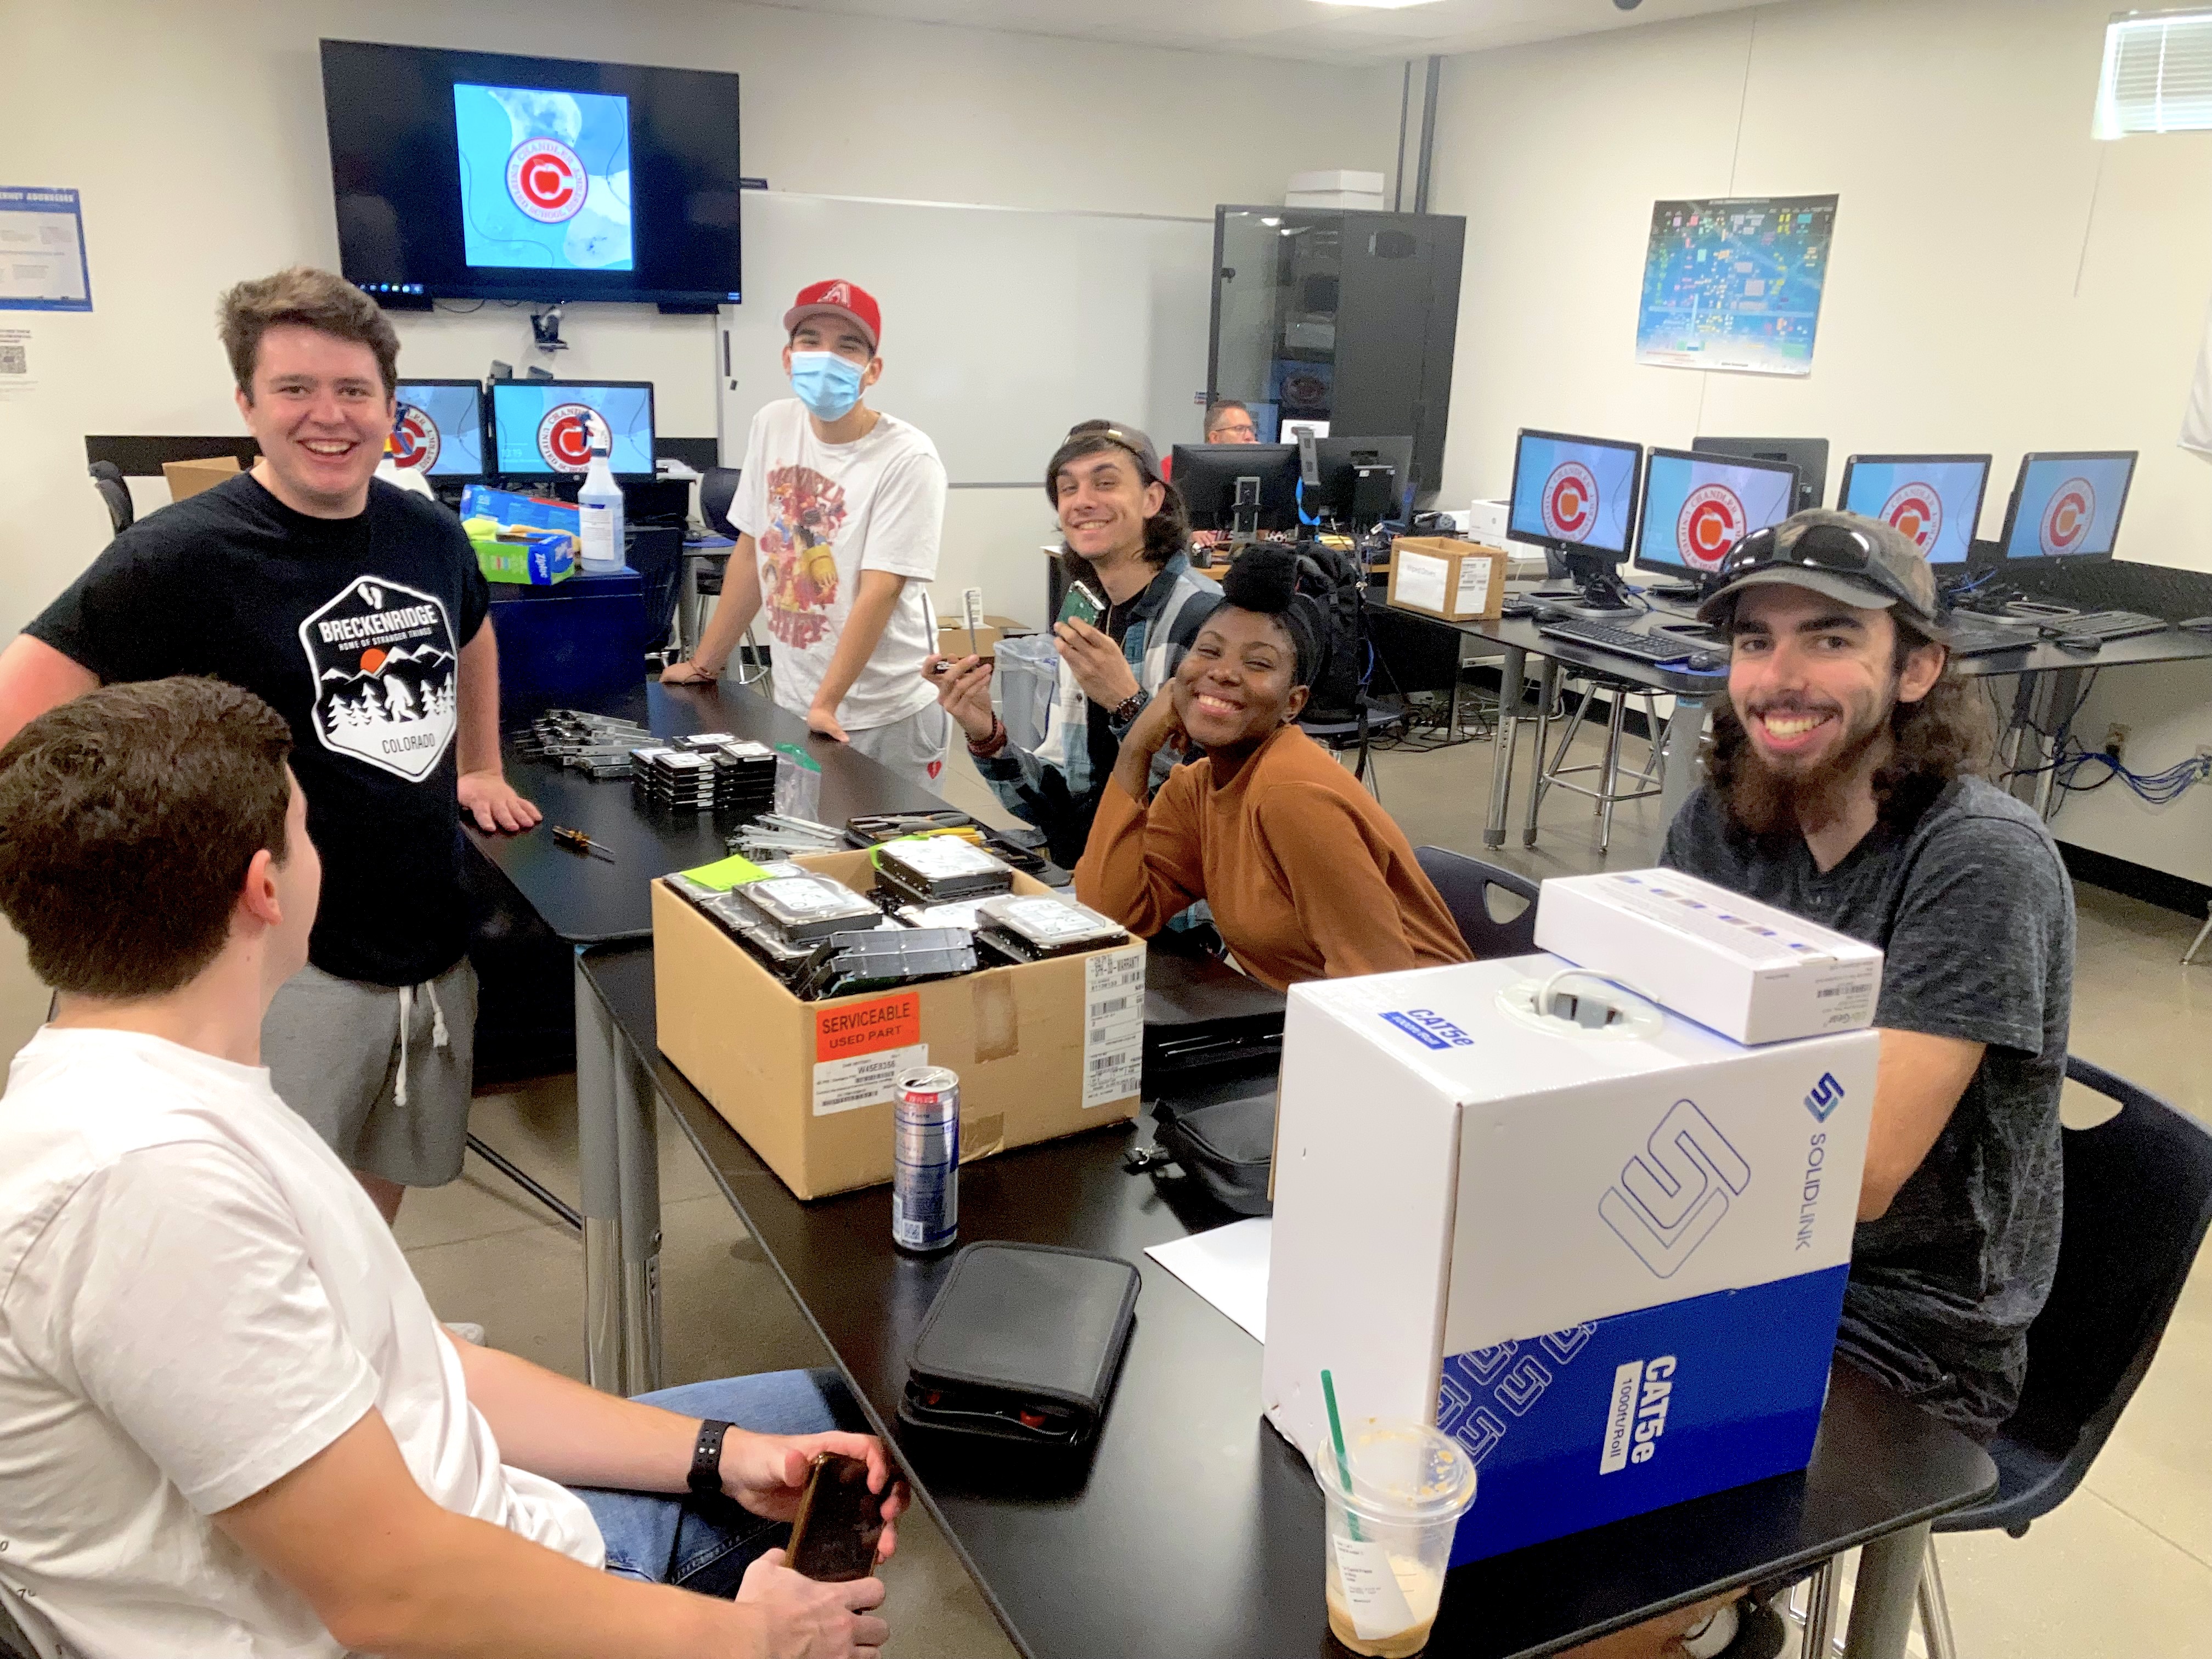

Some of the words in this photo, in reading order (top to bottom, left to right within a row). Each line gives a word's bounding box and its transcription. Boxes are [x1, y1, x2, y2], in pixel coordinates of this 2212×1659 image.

[816, 279, 851, 307] A
[534, 552, 548, 578] Ziploc
[318, 604, 439, 644] BRECKENRIDGE
[338, 641, 360, 651] HOME
[360, 638, 371, 647] OF
[371, 633, 408, 646] STRANGER
[382, 733, 436, 754] COLORADO
[822, 1002, 910, 1034] SERVICEABLE
[1407, 1009, 1475, 1046] CAT5e
[830, 1033, 865, 1048] USED
[868, 1025, 901, 1041] PART
[1795, 1132, 1826, 1251] SOLIDLINK
[1610, 1377, 1634, 1458] 1000ft/Roll
[1630, 1355, 1677, 1465] CAT5e
